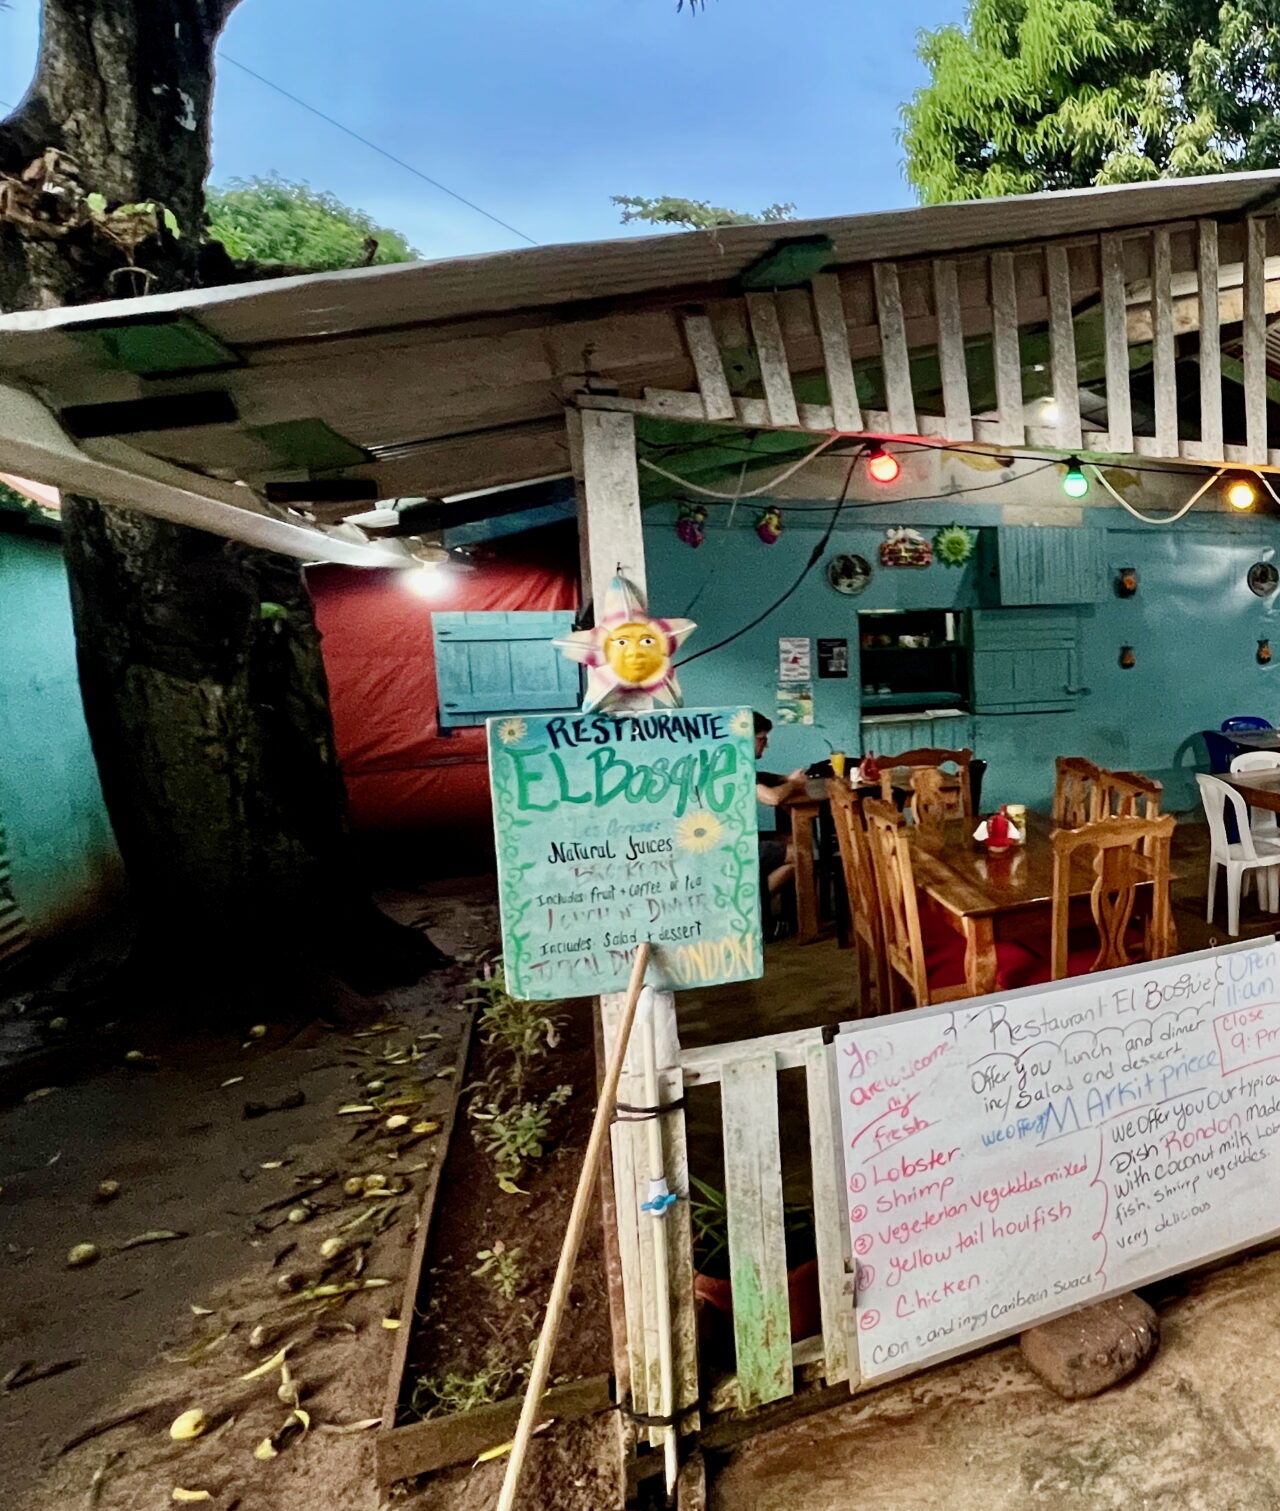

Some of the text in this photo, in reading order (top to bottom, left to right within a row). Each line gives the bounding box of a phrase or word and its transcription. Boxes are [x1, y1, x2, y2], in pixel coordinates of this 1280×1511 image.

[546, 713, 728, 749] RESTAURANTE
[587, 743, 737, 817] Bosque
[626, 836, 673, 860] Juices
[968, 1002, 1107, 1050] Restaurant
